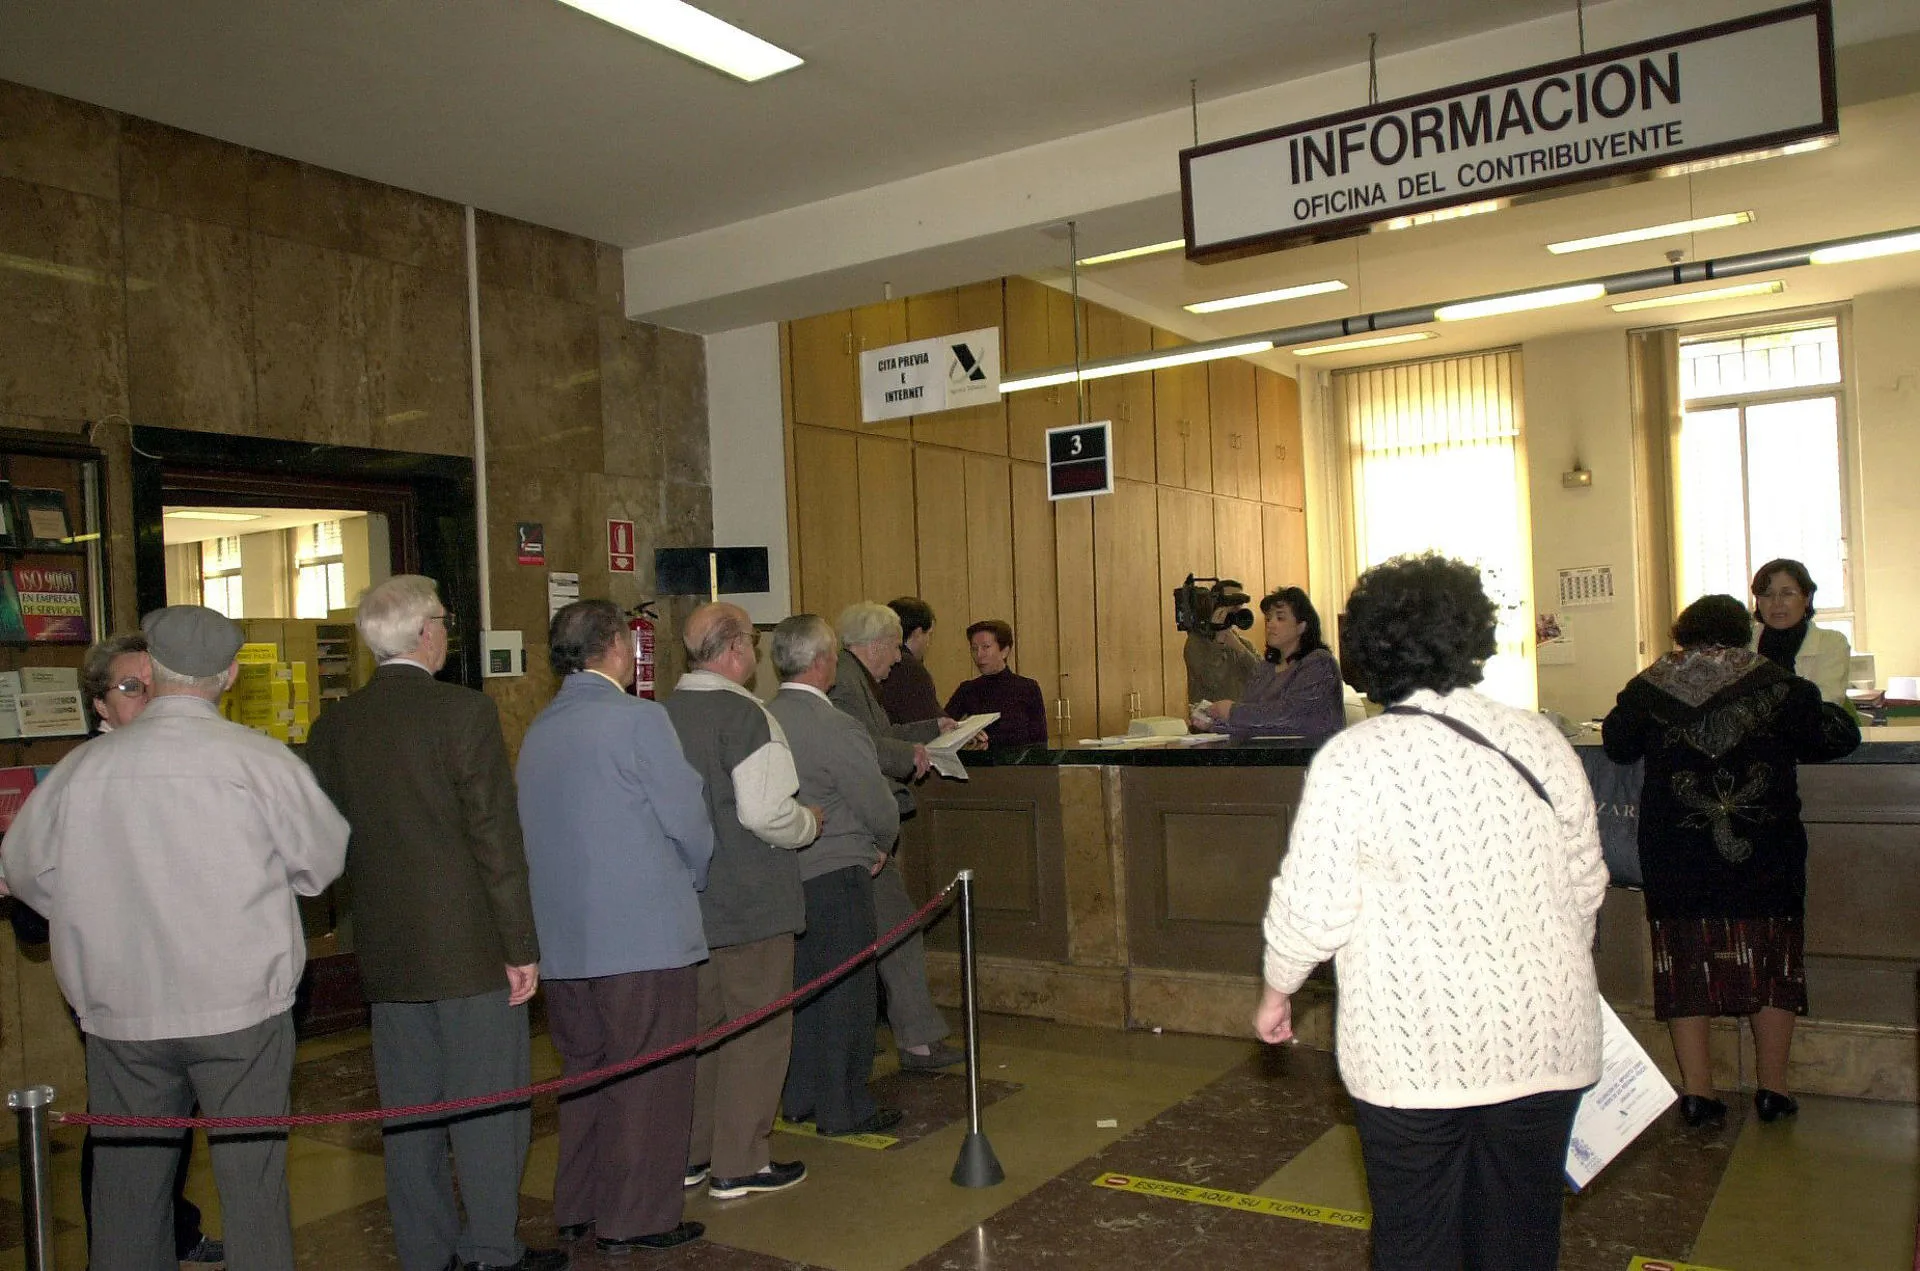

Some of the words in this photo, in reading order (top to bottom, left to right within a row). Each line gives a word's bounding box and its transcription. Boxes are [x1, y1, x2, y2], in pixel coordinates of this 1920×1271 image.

[1289, 52, 1681, 184] INFORMACION
[1294, 183, 1386, 220] OFICINA
[1398, 171, 1446, 200] DEL
[1457, 120, 1683, 187] CONTRIBUYENTE
[878, 358, 897, 372] CITA
[898, 353, 929, 368] PREVIA
[901, 372, 906, 384] E
[885, 386, 924, 403] INTERNET
[1070, 435, 1082, 455] 3
[19, 570, 43, 590] ISO
[22, 593, 34, 602] EN
[36, 593, 78, 603] EMPRESAS
[23, 605, 34, 614] DE
[37, 605, 81, 615] SERVICIOS
[1597, 803, 1636, 817] ZAR
[1134, 1181, 1192, 1196] ESPERE
[1198, 1191, 1234, 1203] AQUI
[1238, 1198, 1260, 1208] SU
[1267, 1202, 1320, 1217] TURNO
[1329, 1212, 1365, 1224] POR
